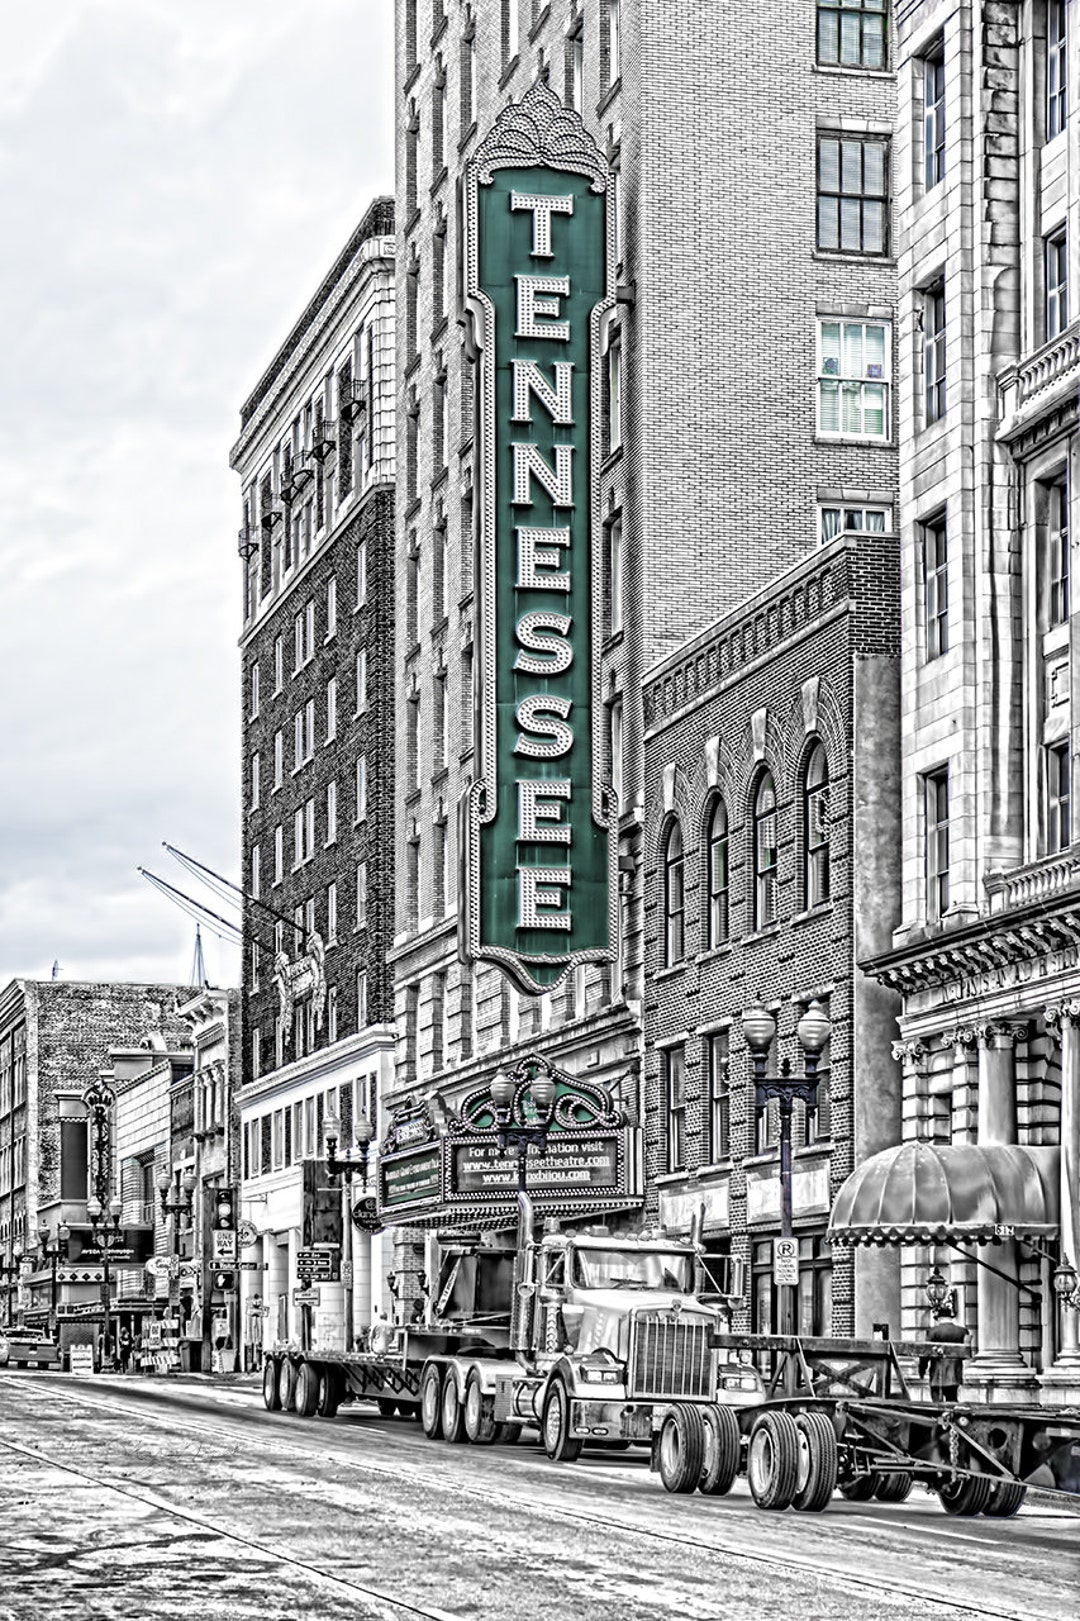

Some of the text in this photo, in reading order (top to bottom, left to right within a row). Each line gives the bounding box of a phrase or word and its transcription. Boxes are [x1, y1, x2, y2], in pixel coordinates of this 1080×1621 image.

[510, 189, 575, 931] TENNESSEE
[468, 1147, 485, 1157] For
[488, 1146, 515, 1156] mre
[581, 1141, 604, 1152] visit
[463, 1155, 610, 1172] www.tennseetheatre.com
[482, 1170, 591, 1184] www.koxbijou.com
